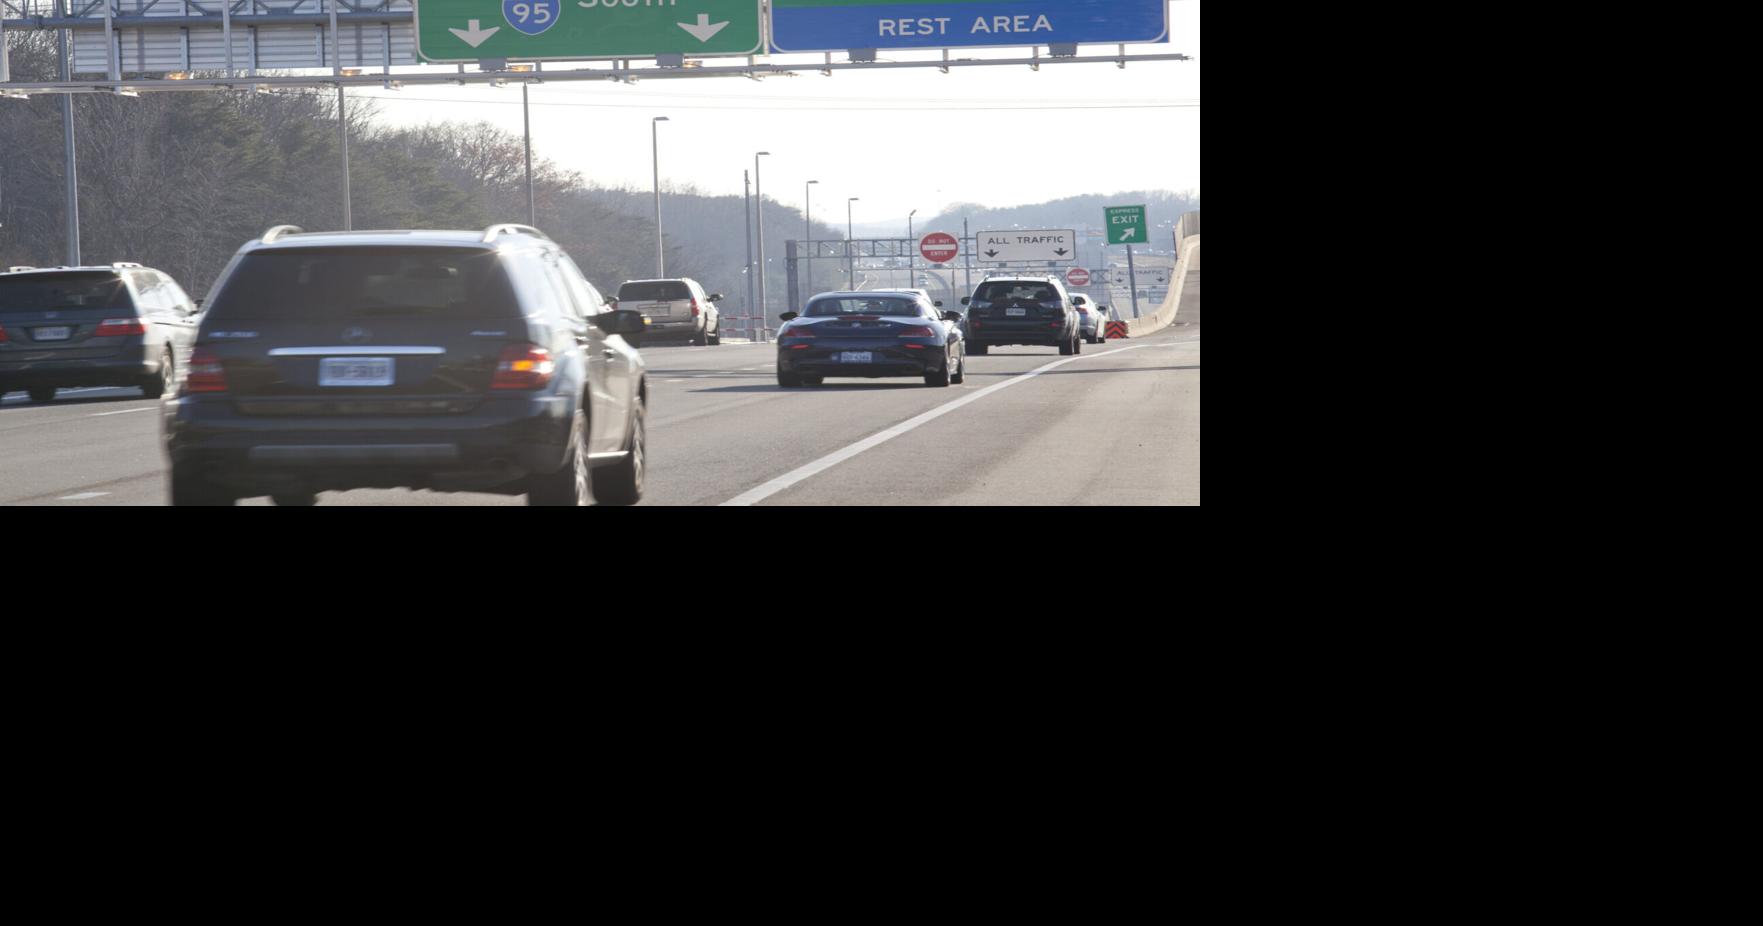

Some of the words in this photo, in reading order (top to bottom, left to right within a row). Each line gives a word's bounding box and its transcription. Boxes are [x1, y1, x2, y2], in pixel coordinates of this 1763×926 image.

[512, 3, 551, 24] 95
[878, 17, 951, 37] REST
[970, 14, 1054, 34] AREA
[1112, 215, 1139, 224] EXIT
[987, 237, 1010, 245] ALL
[1016, 235, 1064, 244] TRAFFIC
